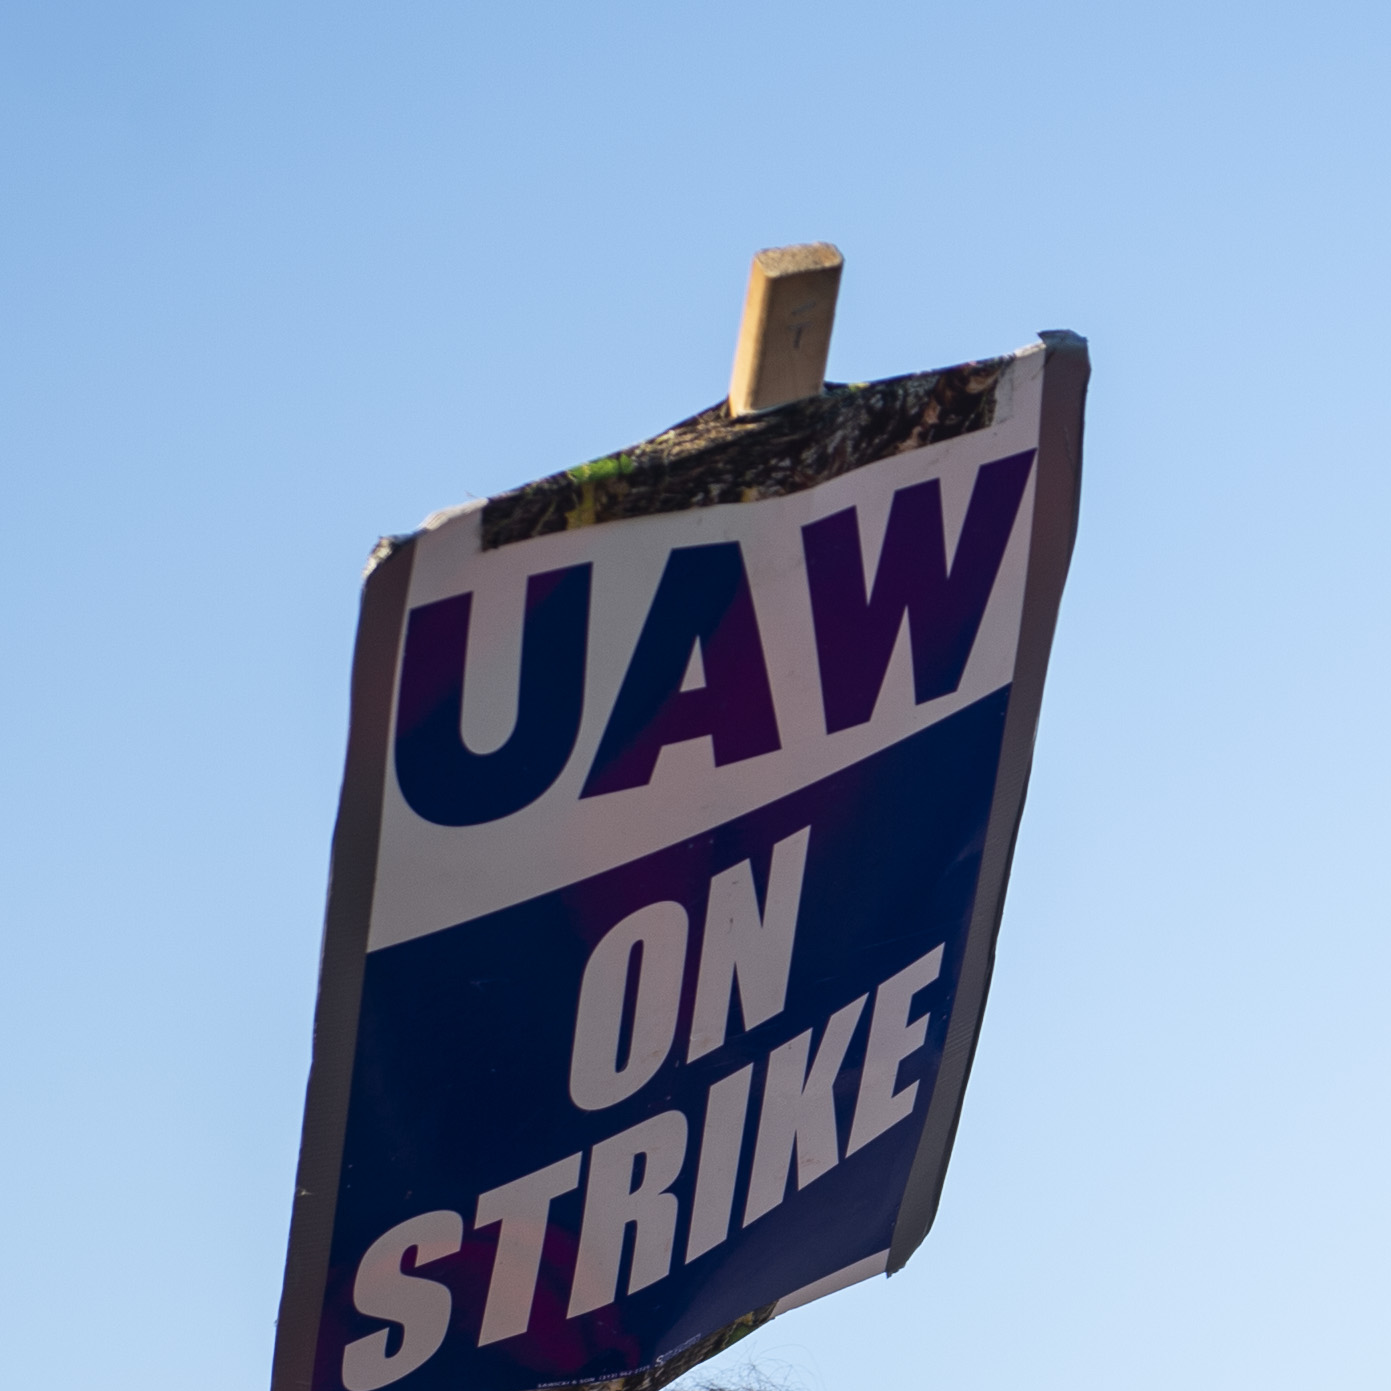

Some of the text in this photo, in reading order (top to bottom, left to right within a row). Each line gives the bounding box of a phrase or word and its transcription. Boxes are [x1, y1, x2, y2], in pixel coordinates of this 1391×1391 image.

[394, 447, 1037, 827] UAW
[569, 825, 811, 1111] ON
[342, 941, 945, 1391] STRIKE
